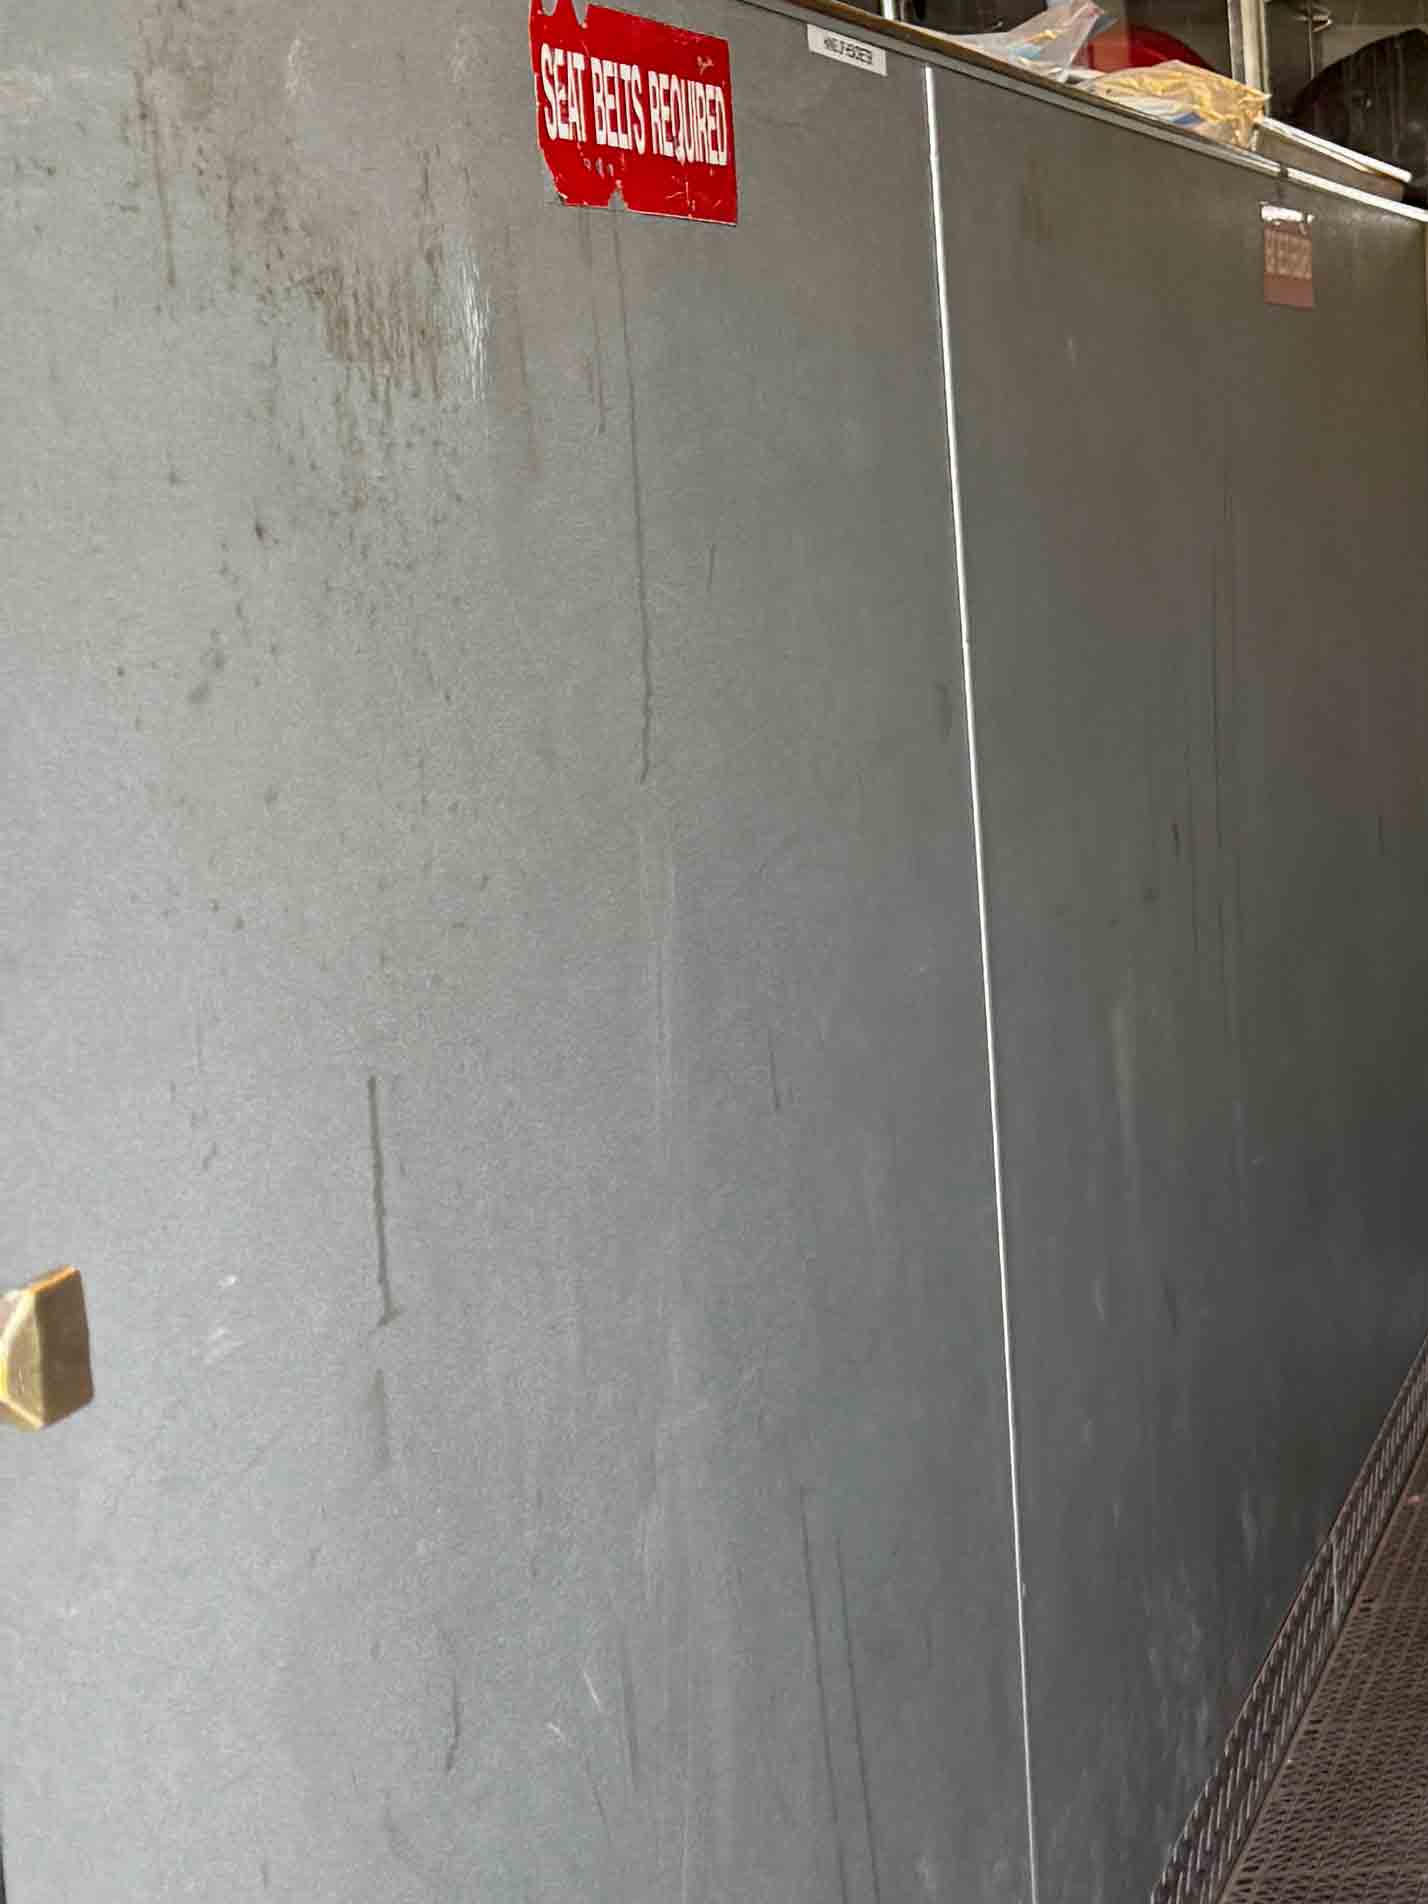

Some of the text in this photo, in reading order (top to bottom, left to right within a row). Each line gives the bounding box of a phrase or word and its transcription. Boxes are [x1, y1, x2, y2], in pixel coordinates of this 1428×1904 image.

[541, 43, 728, 166] SEAT BELTS REQUIRED
